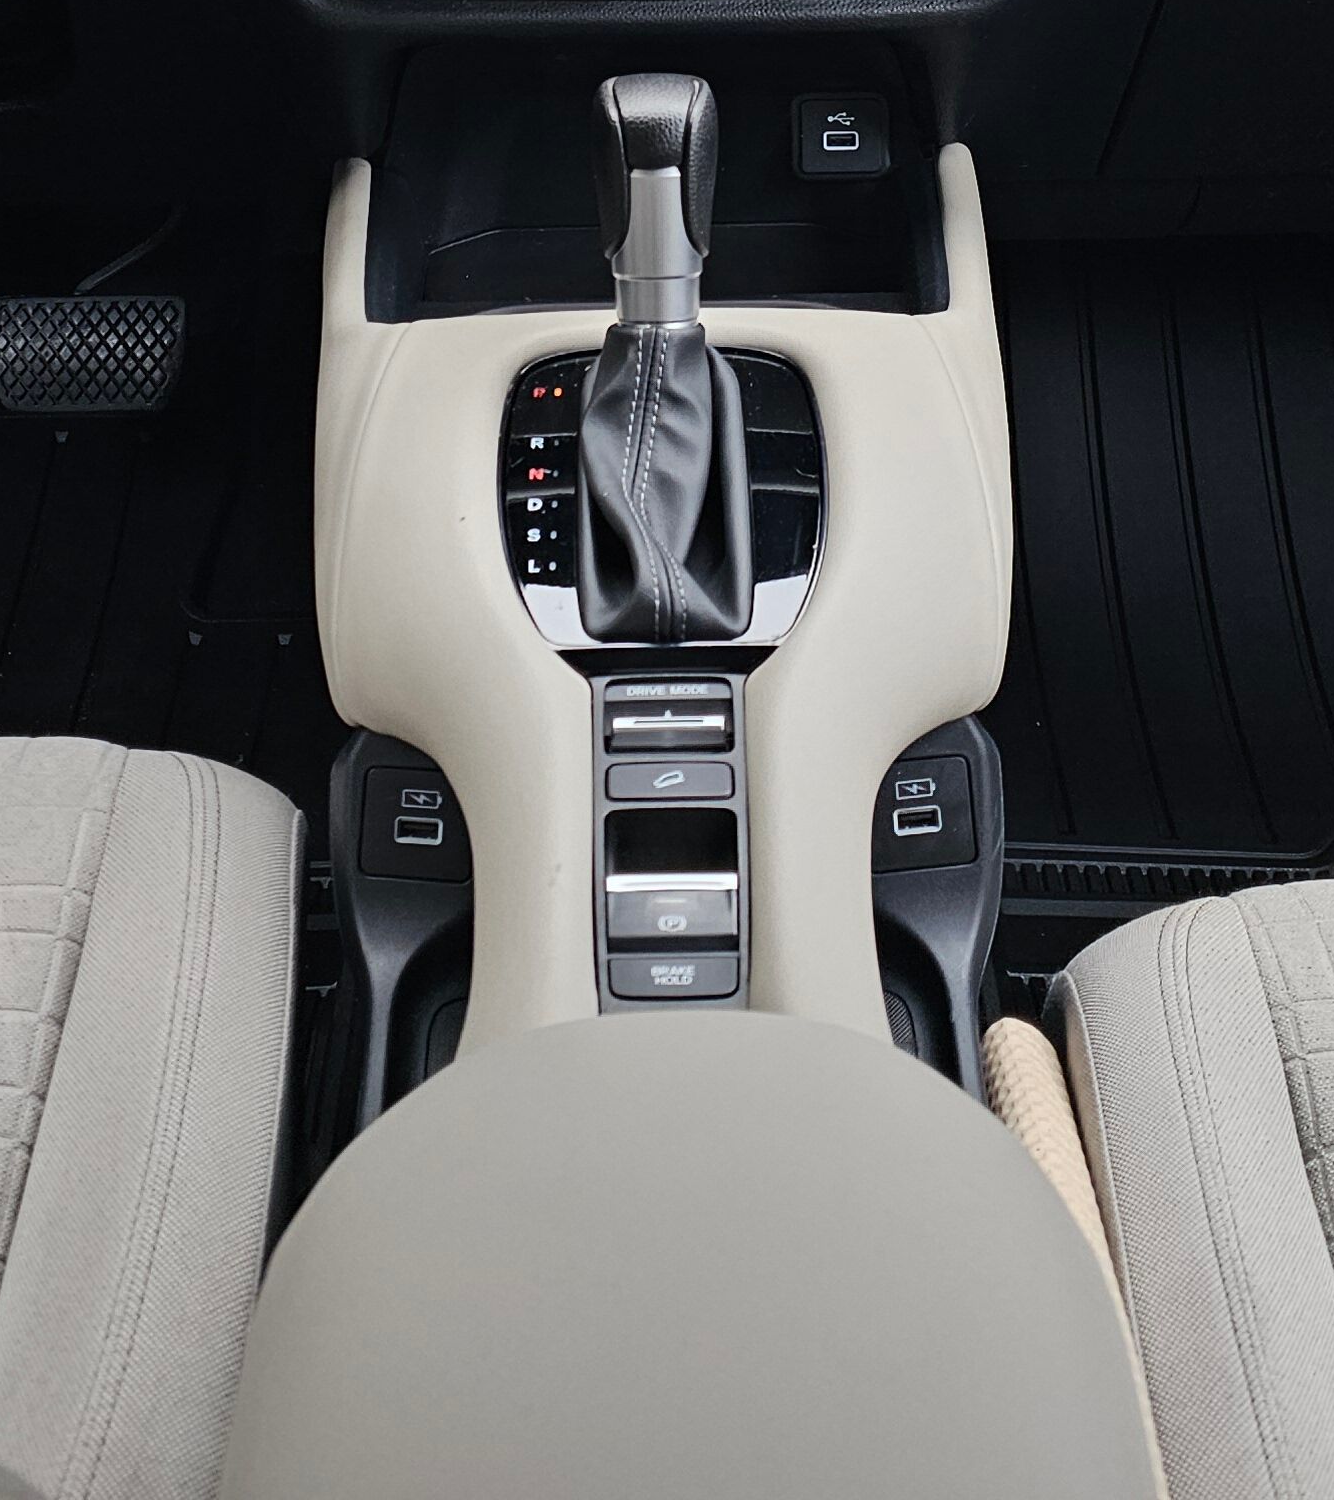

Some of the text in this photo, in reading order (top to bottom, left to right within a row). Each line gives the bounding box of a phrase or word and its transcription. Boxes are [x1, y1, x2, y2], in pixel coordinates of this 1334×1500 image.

[530, 437, 544, 449] R
[529, 468, 544, 480] N
[527, 498, 543, 511] D
[527, 528, 541, 542] S
[528, 560, 541, 573] L
[627, 684, 708, 696] DRIVE MODE
[651, 965, 695, 977] BRAKE
[654, 975, 693, 986] HOLD
